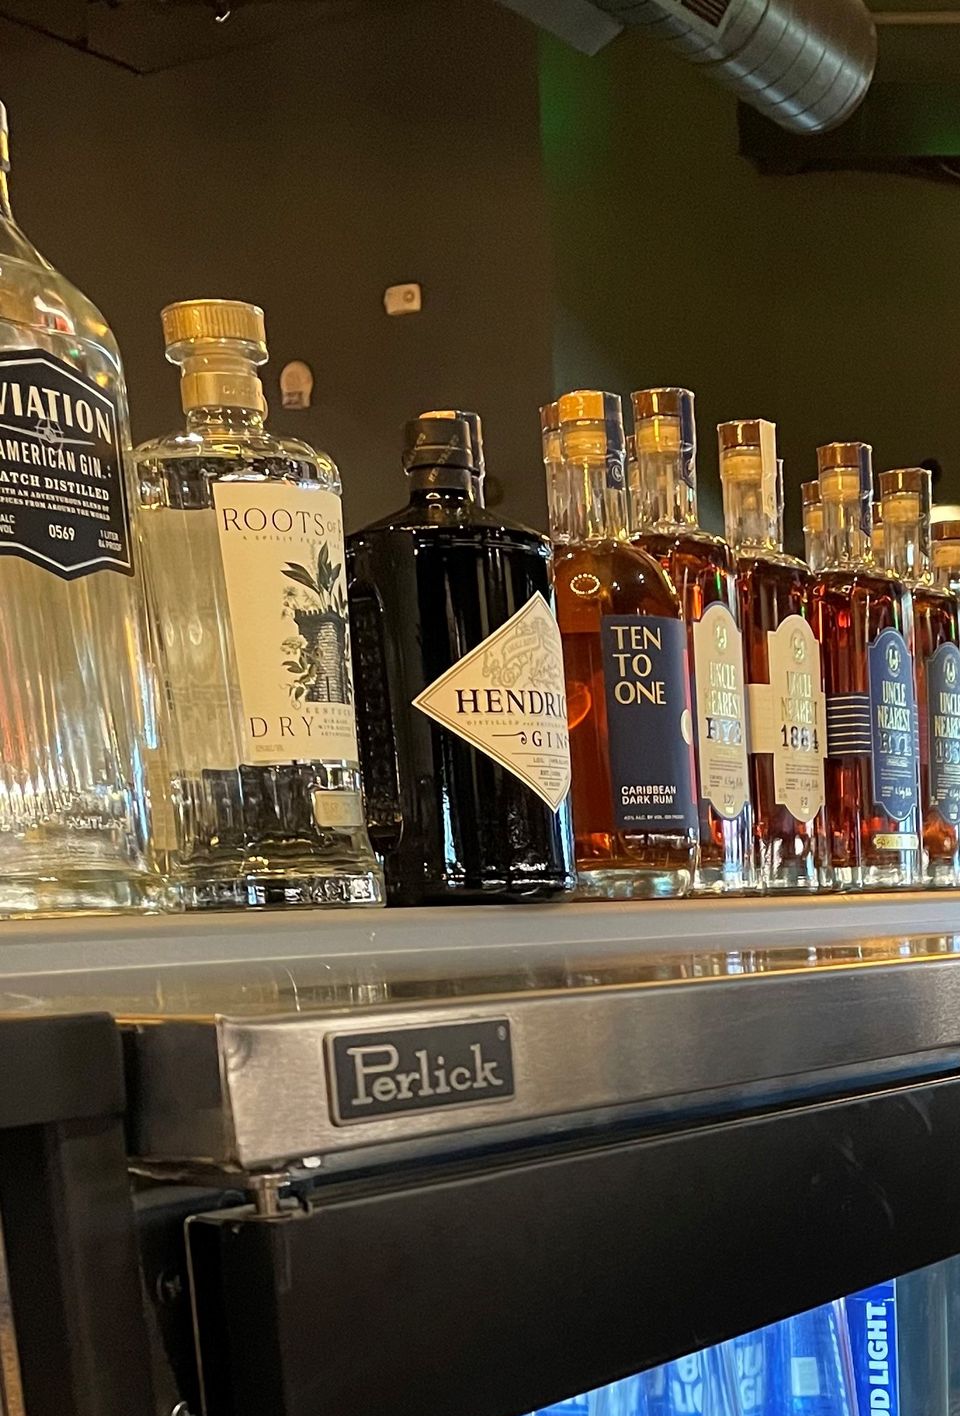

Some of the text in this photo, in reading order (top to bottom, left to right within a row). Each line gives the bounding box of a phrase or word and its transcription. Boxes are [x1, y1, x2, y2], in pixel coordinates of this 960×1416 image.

[44, 476, 109, 501] DISTILLED
[48, 524, 76, 542] 0569
[222, 507, 325, 536] ROOTS
[610, 626, 662, 650] TEN
[612, 653, 652, 677] TO
[614, 681, 667, 705] ONE
[881, 680, 906, 706] UNCLE
[250, 716, 314, 738] DRY
[877, 705, 911, 734] NEAREST
[532, 730, 563, 749] GIN
[621, 785, 677, 796] CARIBBEAN
[622, 795, 674, 805] DARK RUM
[346, 1043, 504, 1106] Perlick
[866, 1301, 889, 1386] LIGHT
